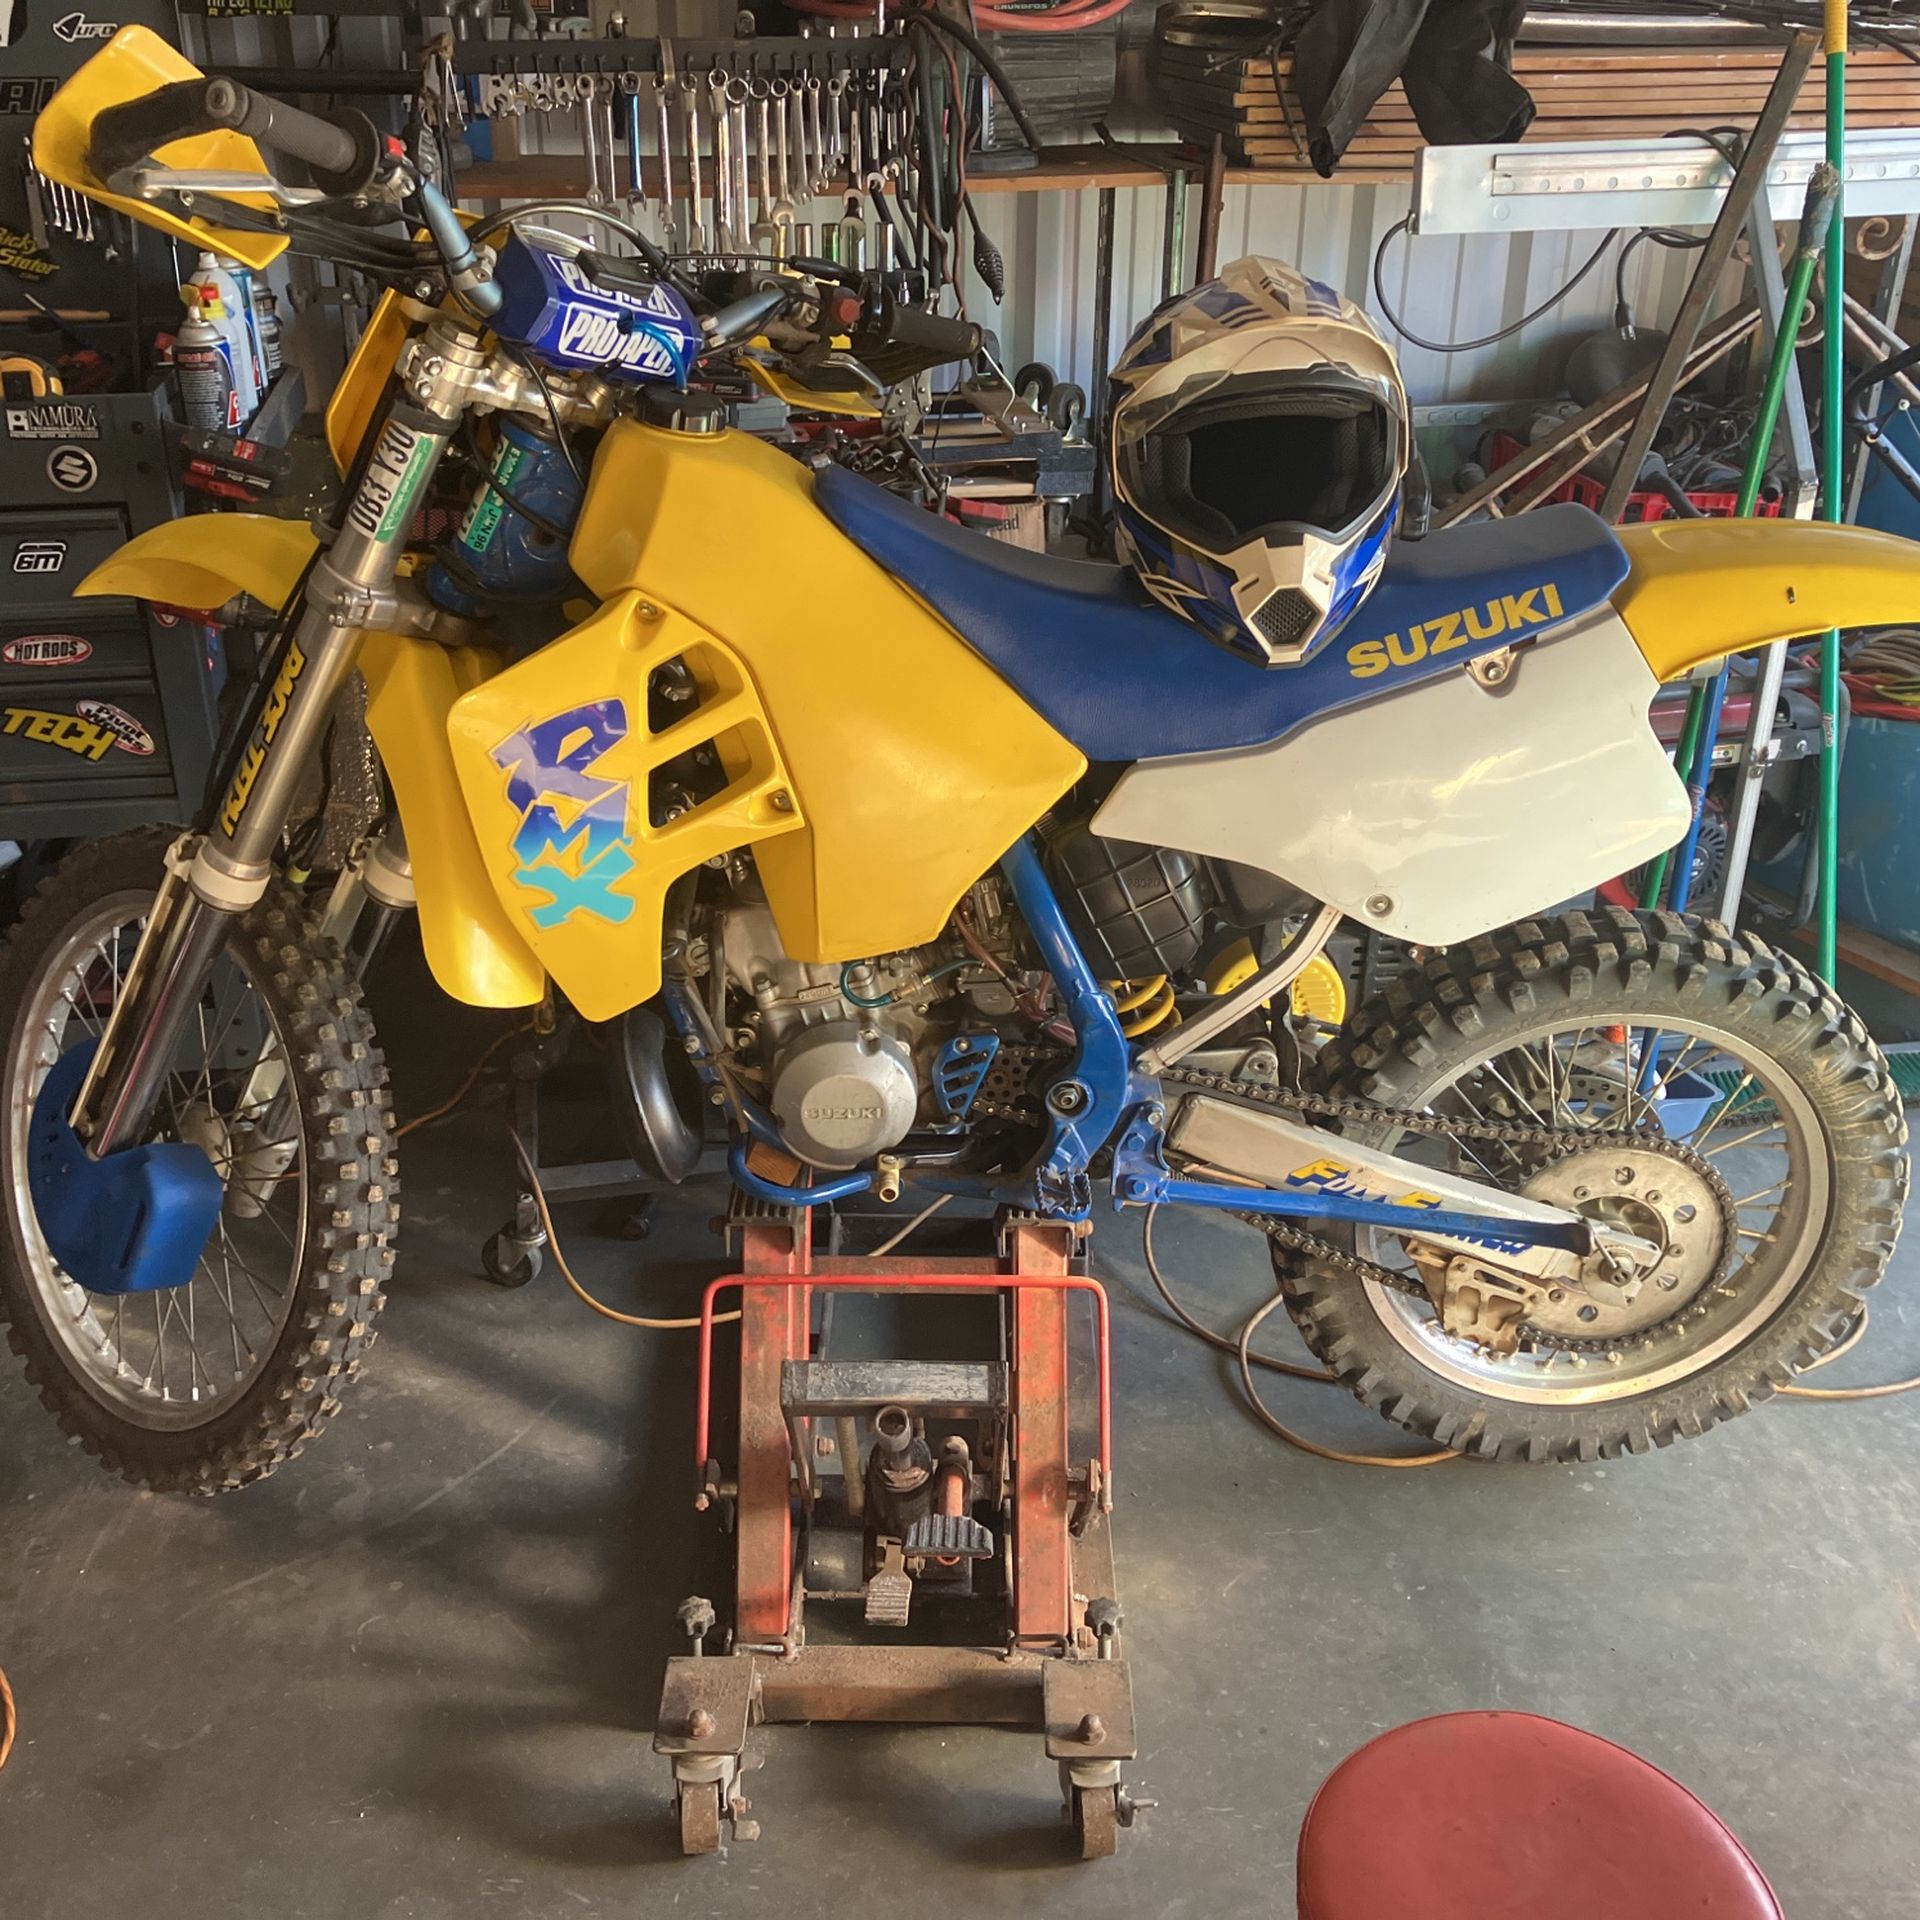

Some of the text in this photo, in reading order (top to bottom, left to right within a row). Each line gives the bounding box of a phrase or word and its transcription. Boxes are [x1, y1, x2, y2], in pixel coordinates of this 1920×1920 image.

[74, 23, 118, 39] UFO
[29, 403, 97, 426] NAMURA
[473, 534, 488, 550] 96
[1346, 583, 1564, 679] SUZUKI
[14, 640, 79, 660] HOT RODS
[2, 707, 118, 761] TECH
[486, 696, 637, 932] RMX
[803, 1107, 884, 1120] SUZUKI
